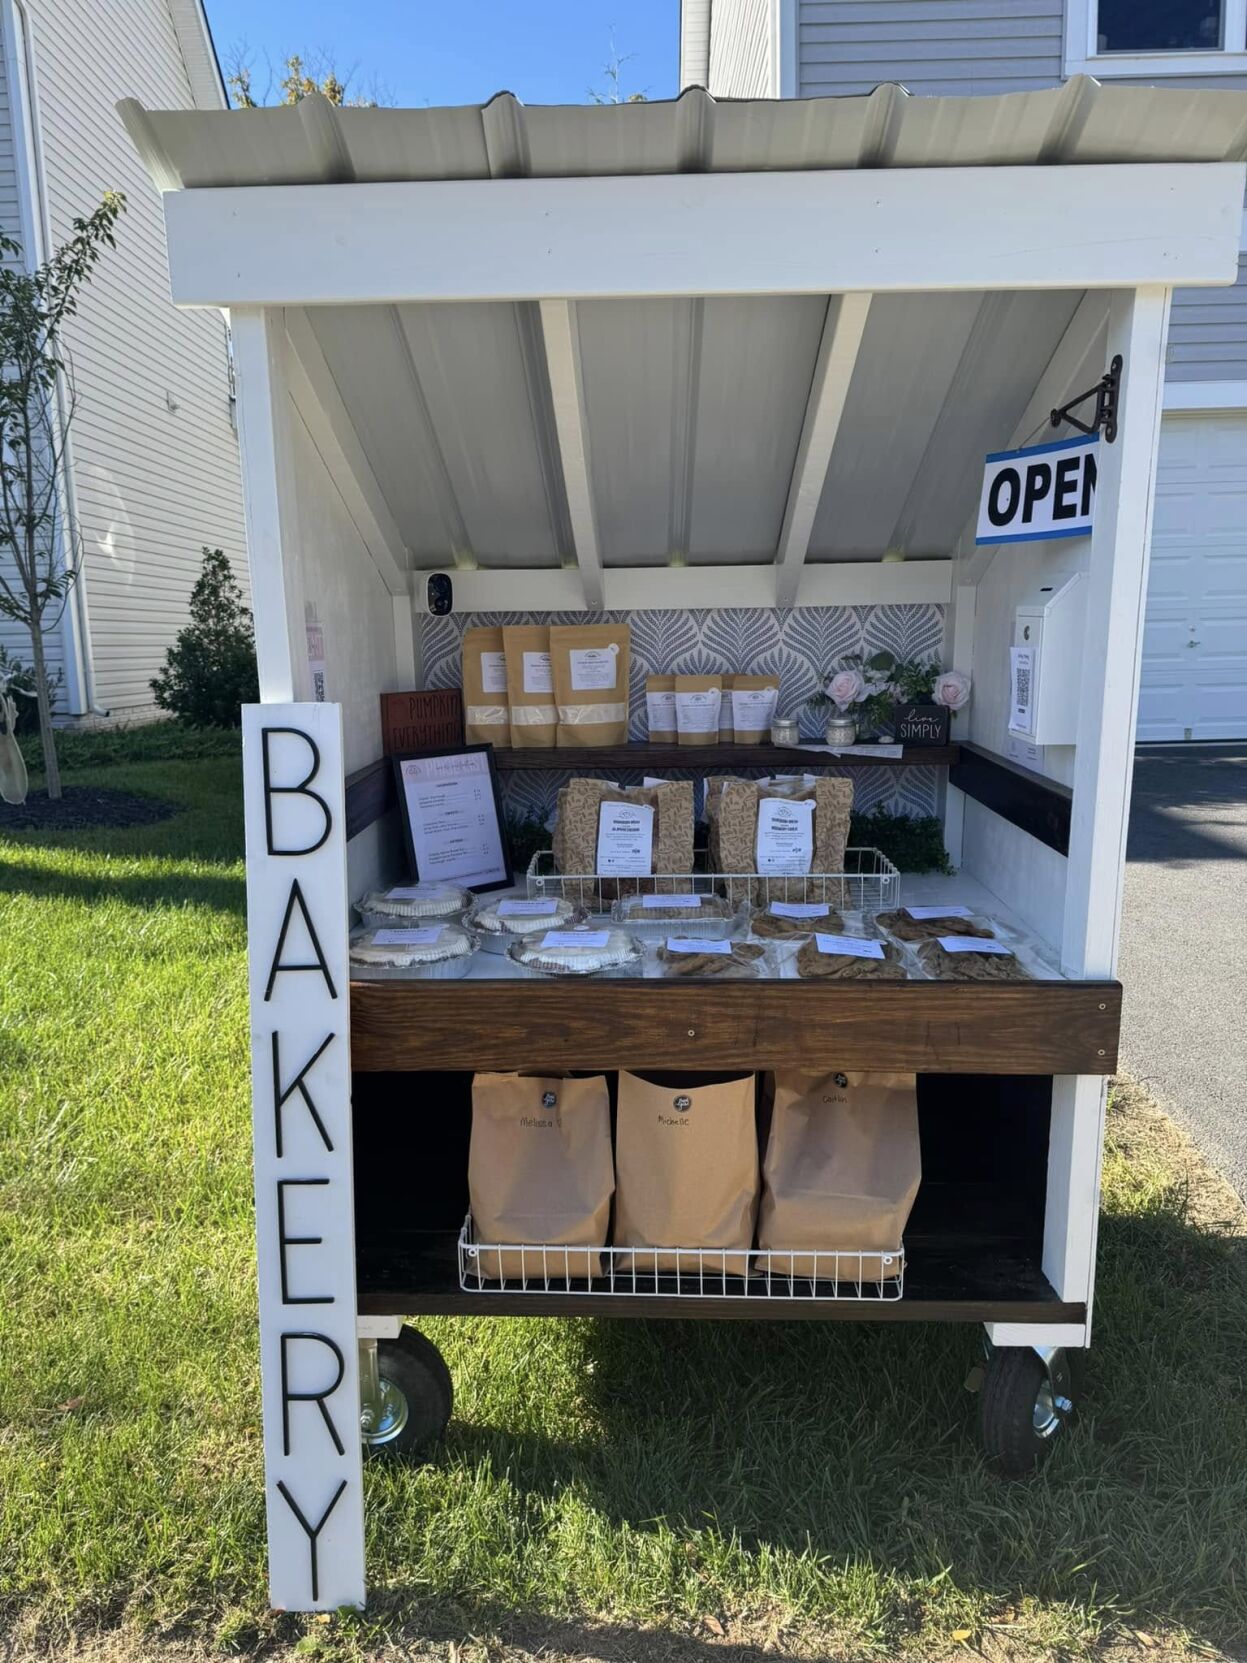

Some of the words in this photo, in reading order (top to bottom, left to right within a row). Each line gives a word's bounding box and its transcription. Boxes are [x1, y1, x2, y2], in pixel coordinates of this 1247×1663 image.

[988, 453, 1097, 527] OPEN
[900, 723, 941, 739] SIMPLY
[261, 727, 347, 1602] BAKERY
